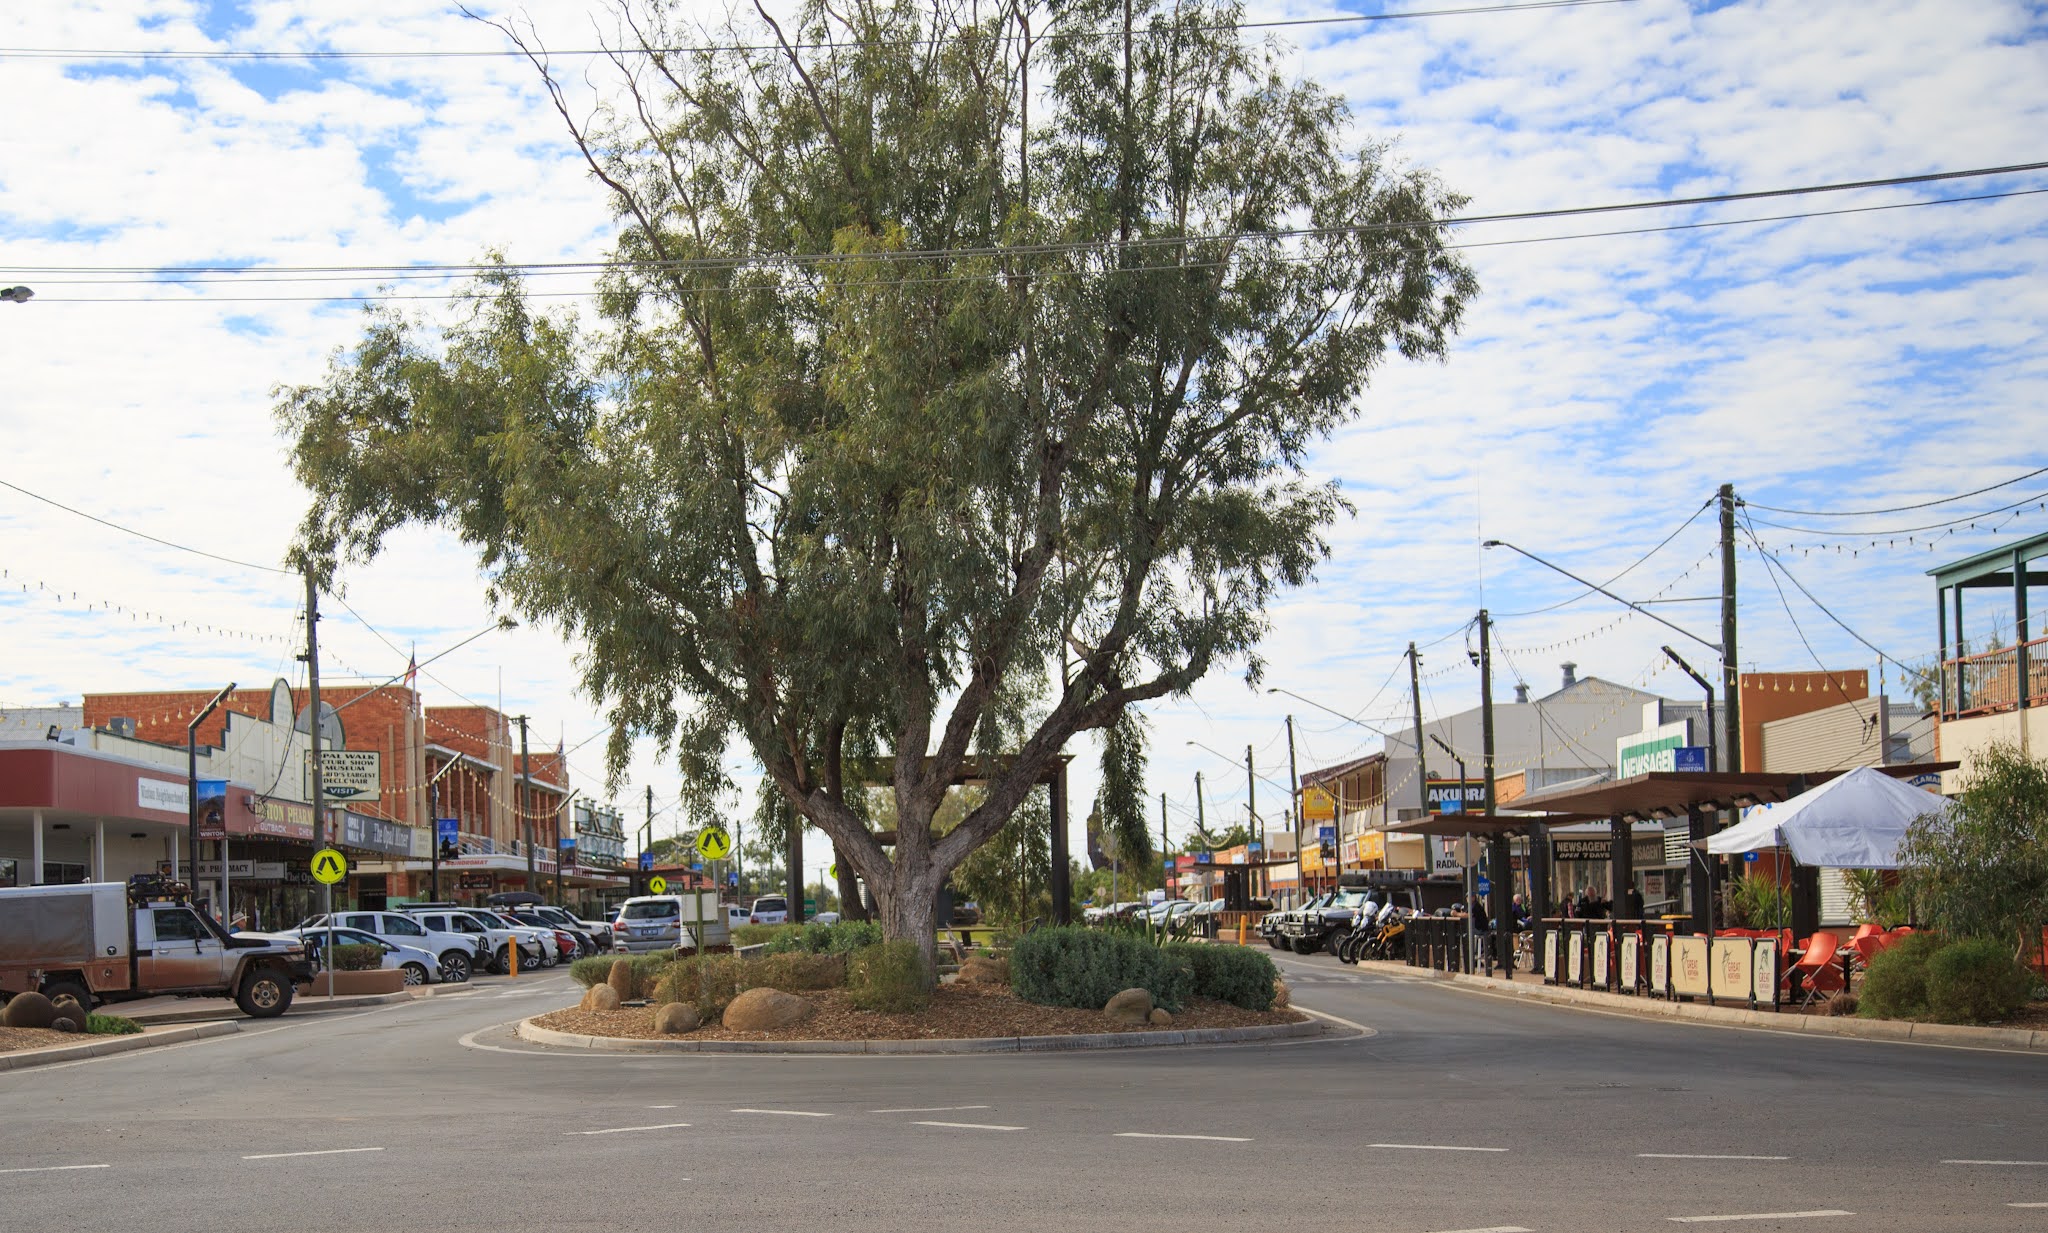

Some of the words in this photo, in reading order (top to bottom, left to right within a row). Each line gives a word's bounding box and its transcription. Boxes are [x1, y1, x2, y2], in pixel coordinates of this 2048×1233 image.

[1623, 749, 1675, 778] NEWSAGEN
[288, 806, 315, 827] PHARM
[347, 816, 359, 829] OPAL
[373, 822, 383, 843] The
[383, 825, 395, 849] Opal
[394, 826, 409, 848] Miner
[1556, 841, 1612, 852] NEWSAGENT
[179, 865, 206, 873] WINN
[210, 864, 249, 872] PHMACY
[1728, 961, 1741, 972] GREAT
